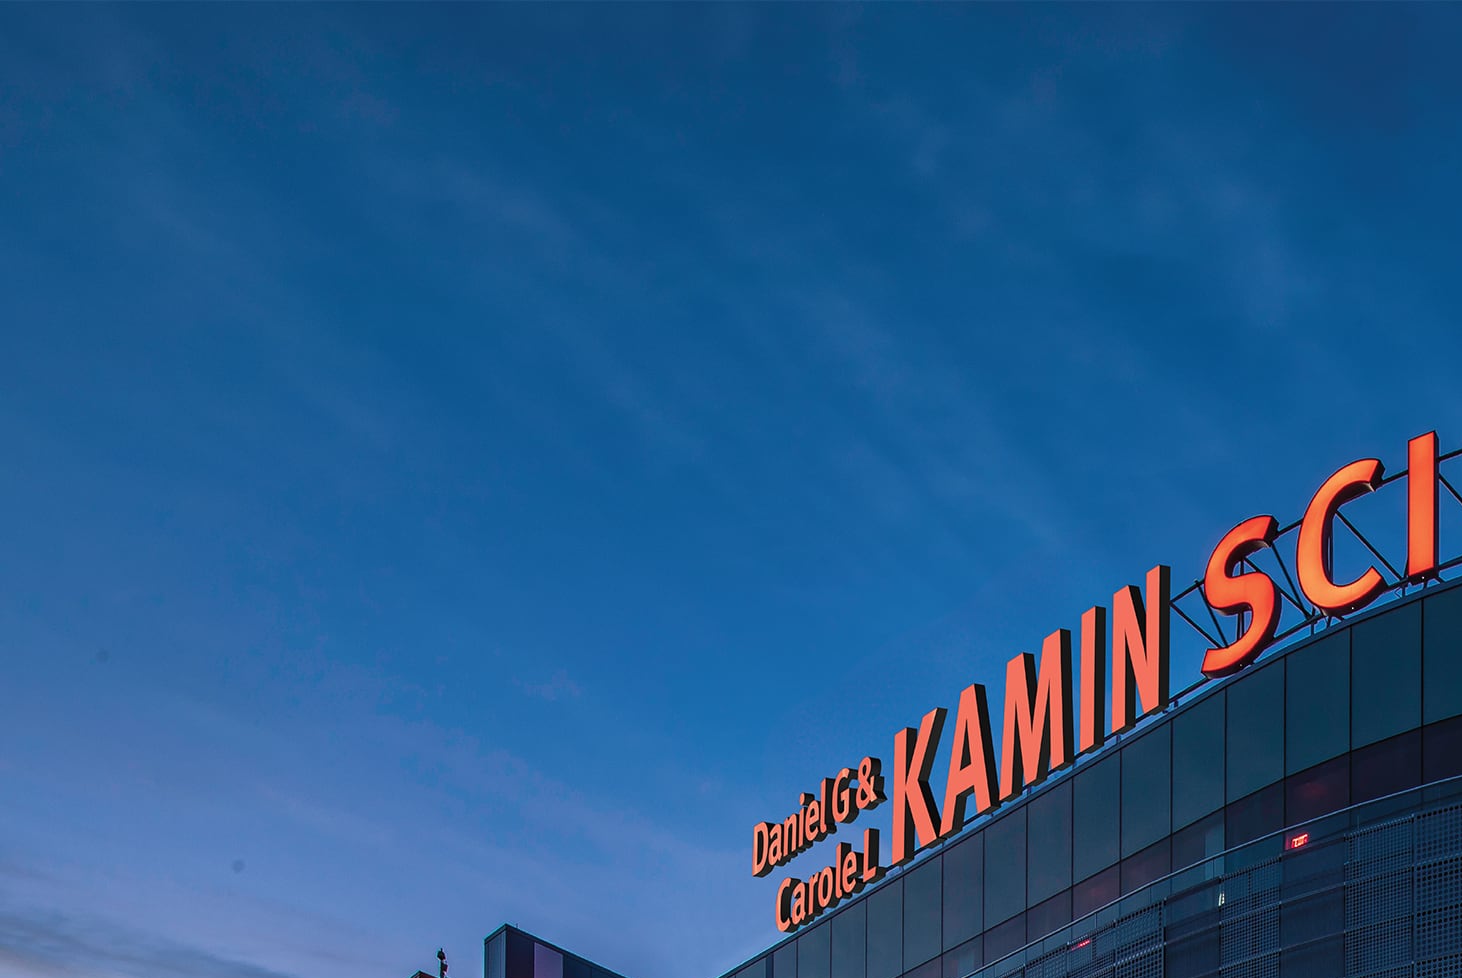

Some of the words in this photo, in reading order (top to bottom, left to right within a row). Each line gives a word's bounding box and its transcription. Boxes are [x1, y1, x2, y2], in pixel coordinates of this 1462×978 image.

[892, 565, 1170, 866] KAMIN
[752, 778, 832, 877] Daniel
[831, 767, 856, 823] G
[855, 756, 885, 810] &
[775, 842, 862, 933] Carole
[863, 828, 882, 883] L
